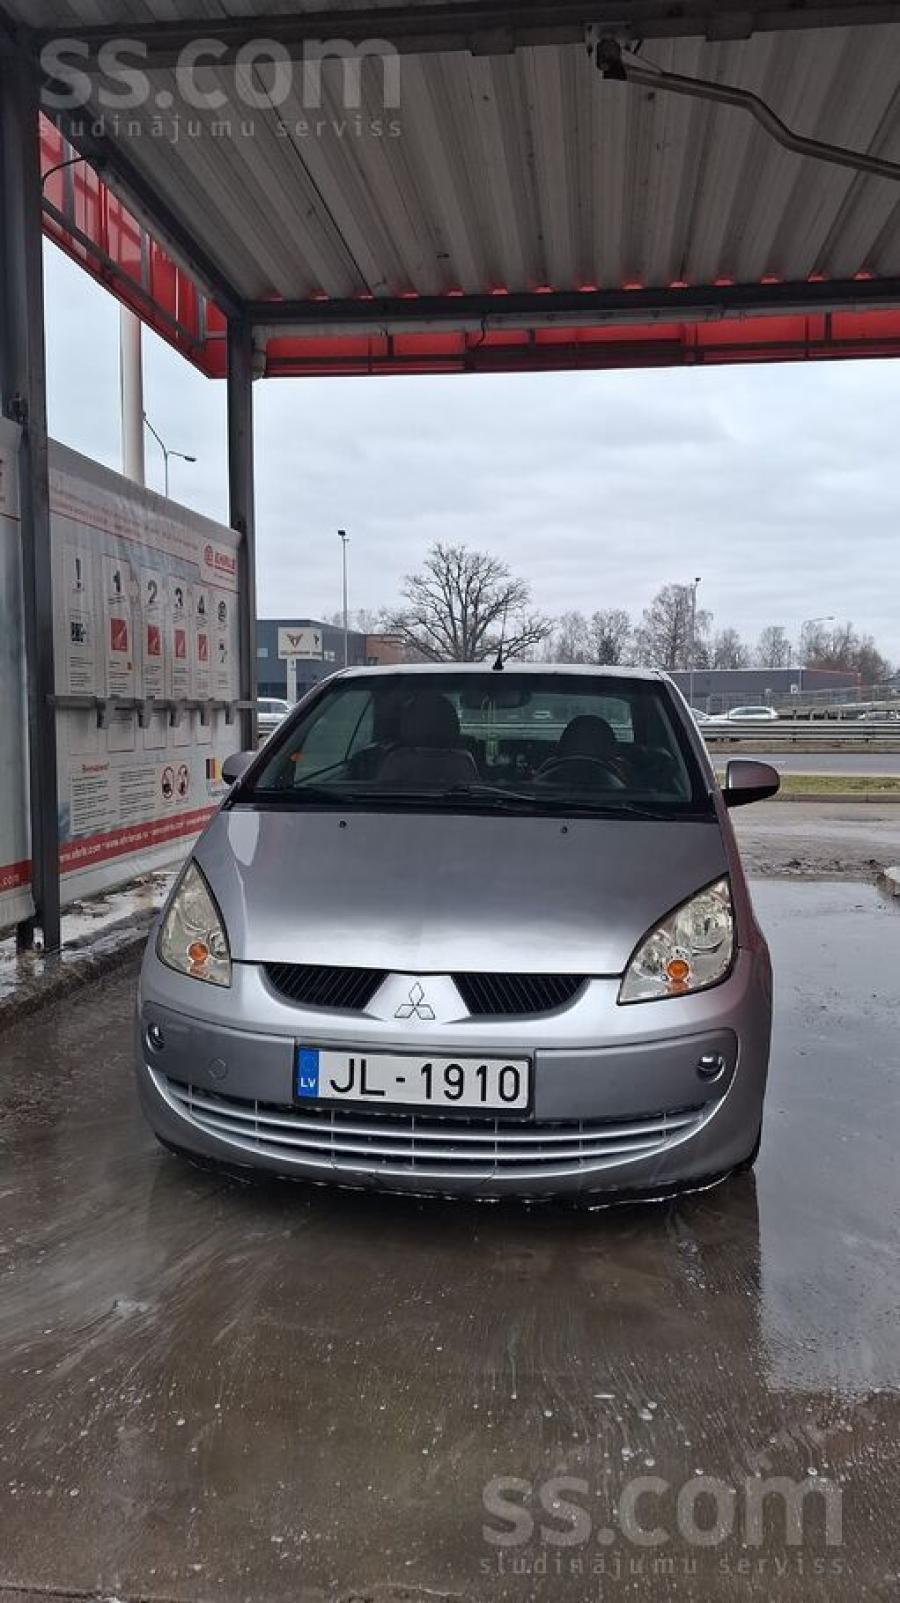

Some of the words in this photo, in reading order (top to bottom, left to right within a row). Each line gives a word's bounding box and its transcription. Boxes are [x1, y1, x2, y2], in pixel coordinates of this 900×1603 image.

[113, 570, 121, 593] 1
[147, 579, 158, 604] 2
[175, 587, 184, 608] 3
[300, 1077, 317, 1089] LV
